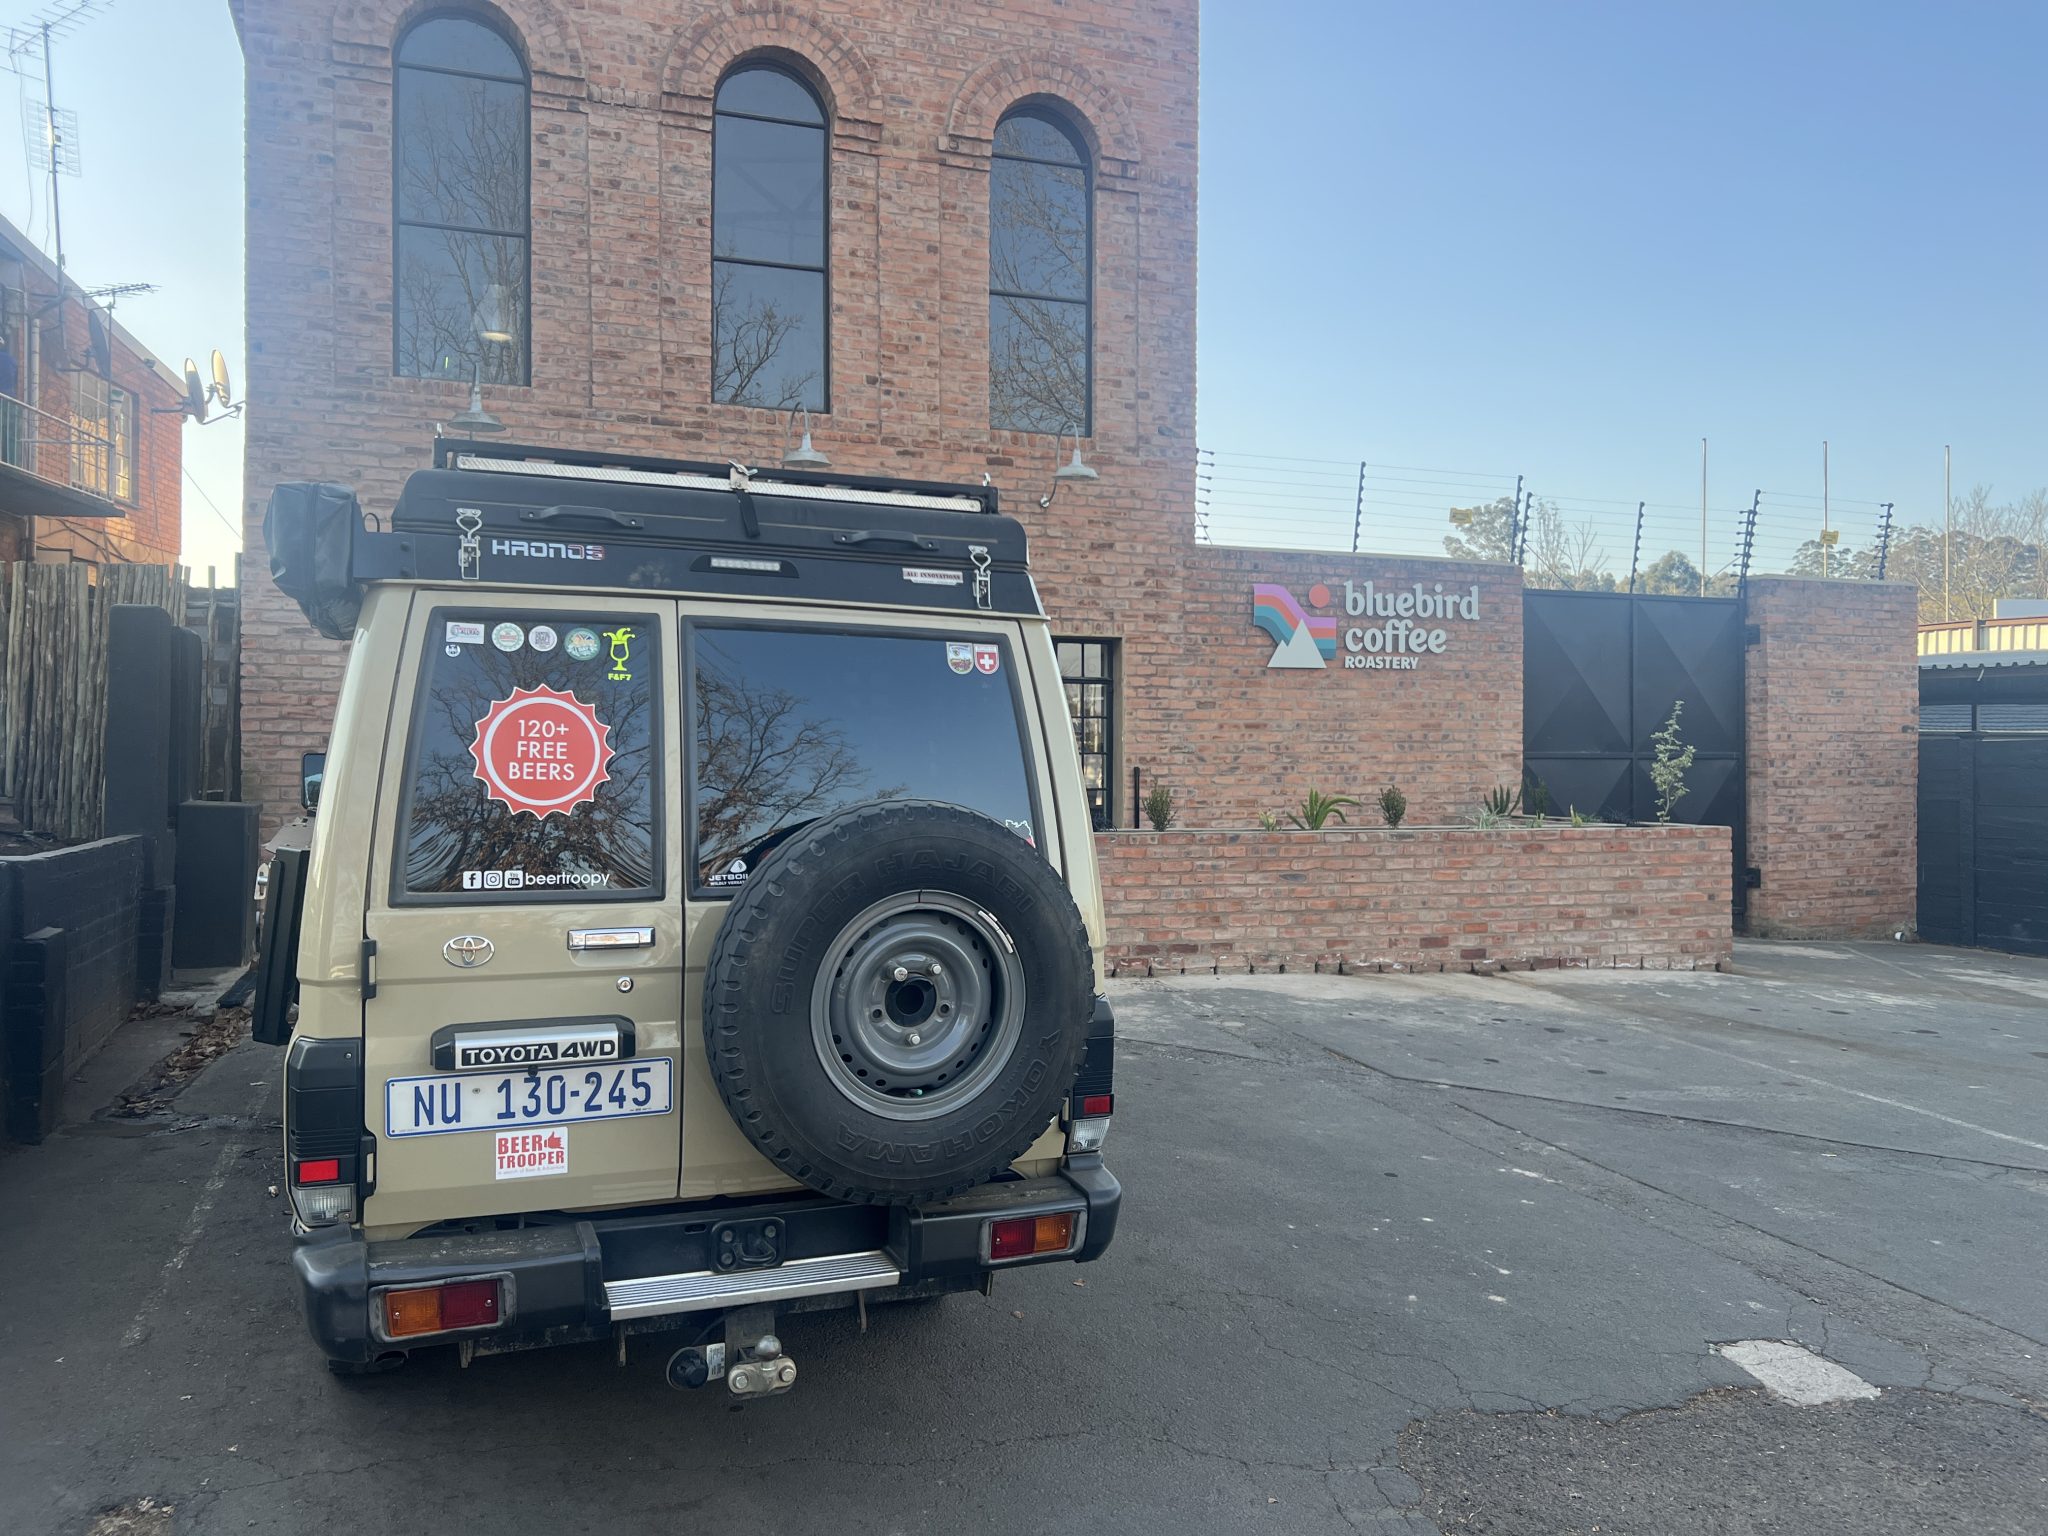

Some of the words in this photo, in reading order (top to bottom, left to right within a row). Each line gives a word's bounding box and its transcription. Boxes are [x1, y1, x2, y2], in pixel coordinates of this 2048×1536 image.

[1343, 580, 1480, 621] bluebird
[1345, 618, 1447, 654] coffee
[1344, 655, 1419, 670] ROASTERY
[607, 673, 632, 681] F&F7
[517, 719, 570, 739] 120+
[516, 741, 568, 760] FREE
[508, 762, 575, 781] BEERS
[525, 871, 610, 887] beertroopy
[466, 1044, 554, 1064] TOYOTA
[560, 1039, 616, 1059] 4WD
[413, 1082, 461, 1127] NU
[496, 1067, 652, 1120] 130-245
[835, 1029, 1062, 1165] YOKOHAMA
[497, 1134, 543, 1155] BEER
[497, 1150, 565, 1170] TROOPER
